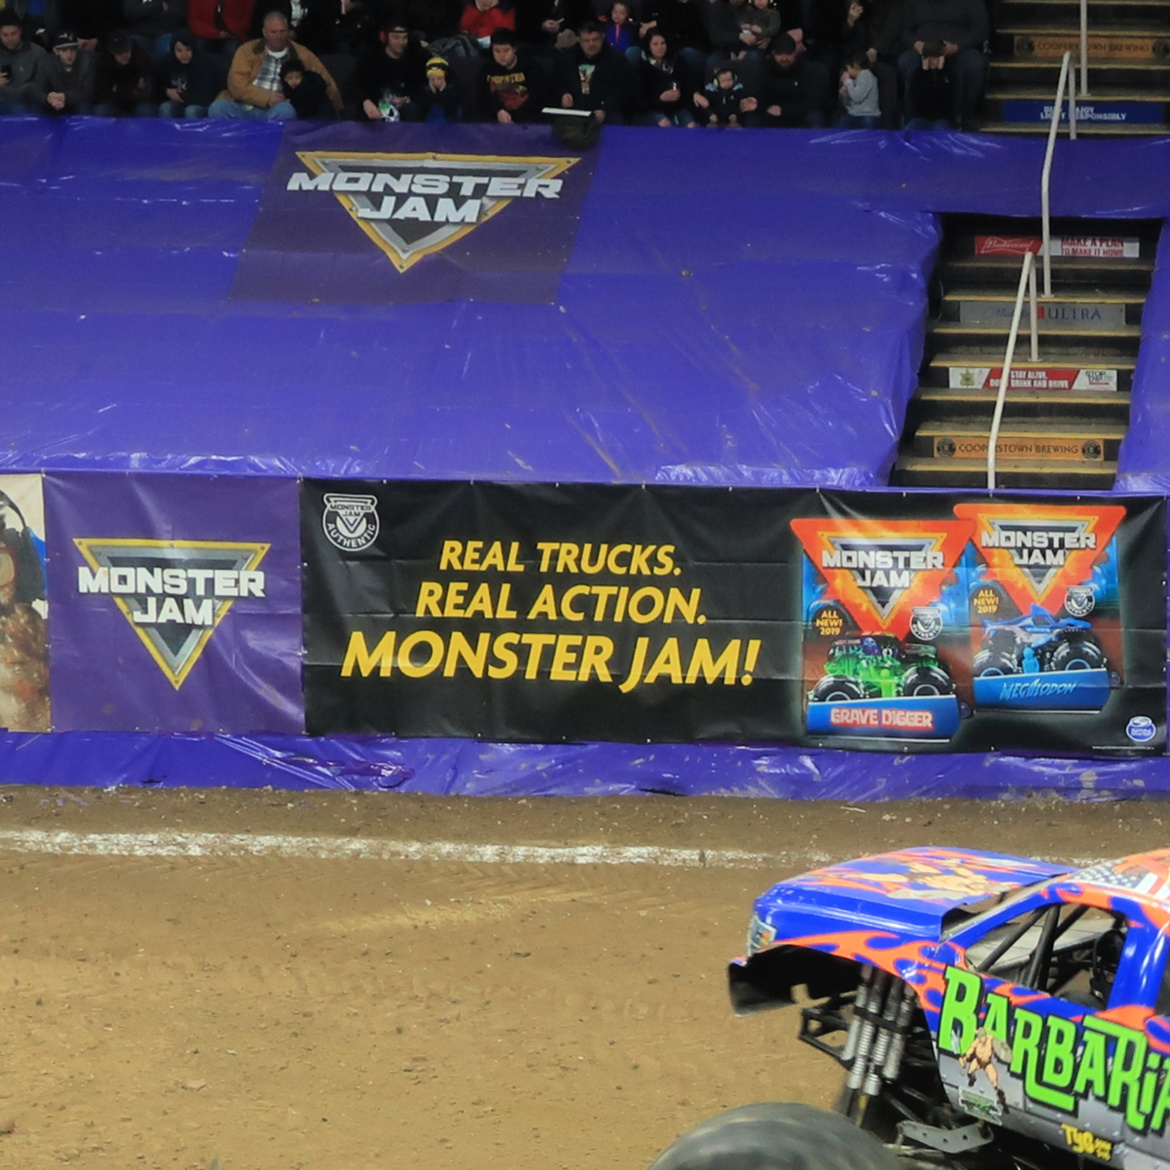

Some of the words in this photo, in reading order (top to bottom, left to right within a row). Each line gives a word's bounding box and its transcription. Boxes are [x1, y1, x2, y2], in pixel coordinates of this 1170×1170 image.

[287, 173, 563, 198] MONSTER
[357, 197, 481, 222] JAM
[1048, 308, 1101, 320] ULTRA
[1035, 444, 1079, 454] BREWING
[327, 523, 376, 548] AUTHENTIC
[981, 531, 1097, 549] MONSTER
[439, 540, 525, 572] REAL
[536, 542, 682, 576] TRUCKS.
[822, 551, 944, 570] MONSTER
[1014, 549, 1065, 565] JAM
[78, 566, 266, 597] MONSTER
[857, 570, 911, 588] JAM
[415, 582, 517, 619] REAL
[527, 584, 707, 624] ACTION.
[978, 590, 995, 598] ALL
[133, 597, 213, 625] JAM
[821, 610, 839, 618] ALL
[977, 605, 998, 613] 2019
[820, 627, 841, 635] 2019
[341, 630, 614, 682] MONSTER
[618, 637, 762, 693] JAM!
[1000, 678, 1077, 701] MEGALODON
[830, 707, 879, 727] GRAVE
[881, 709, 934, 730] DIGGER
